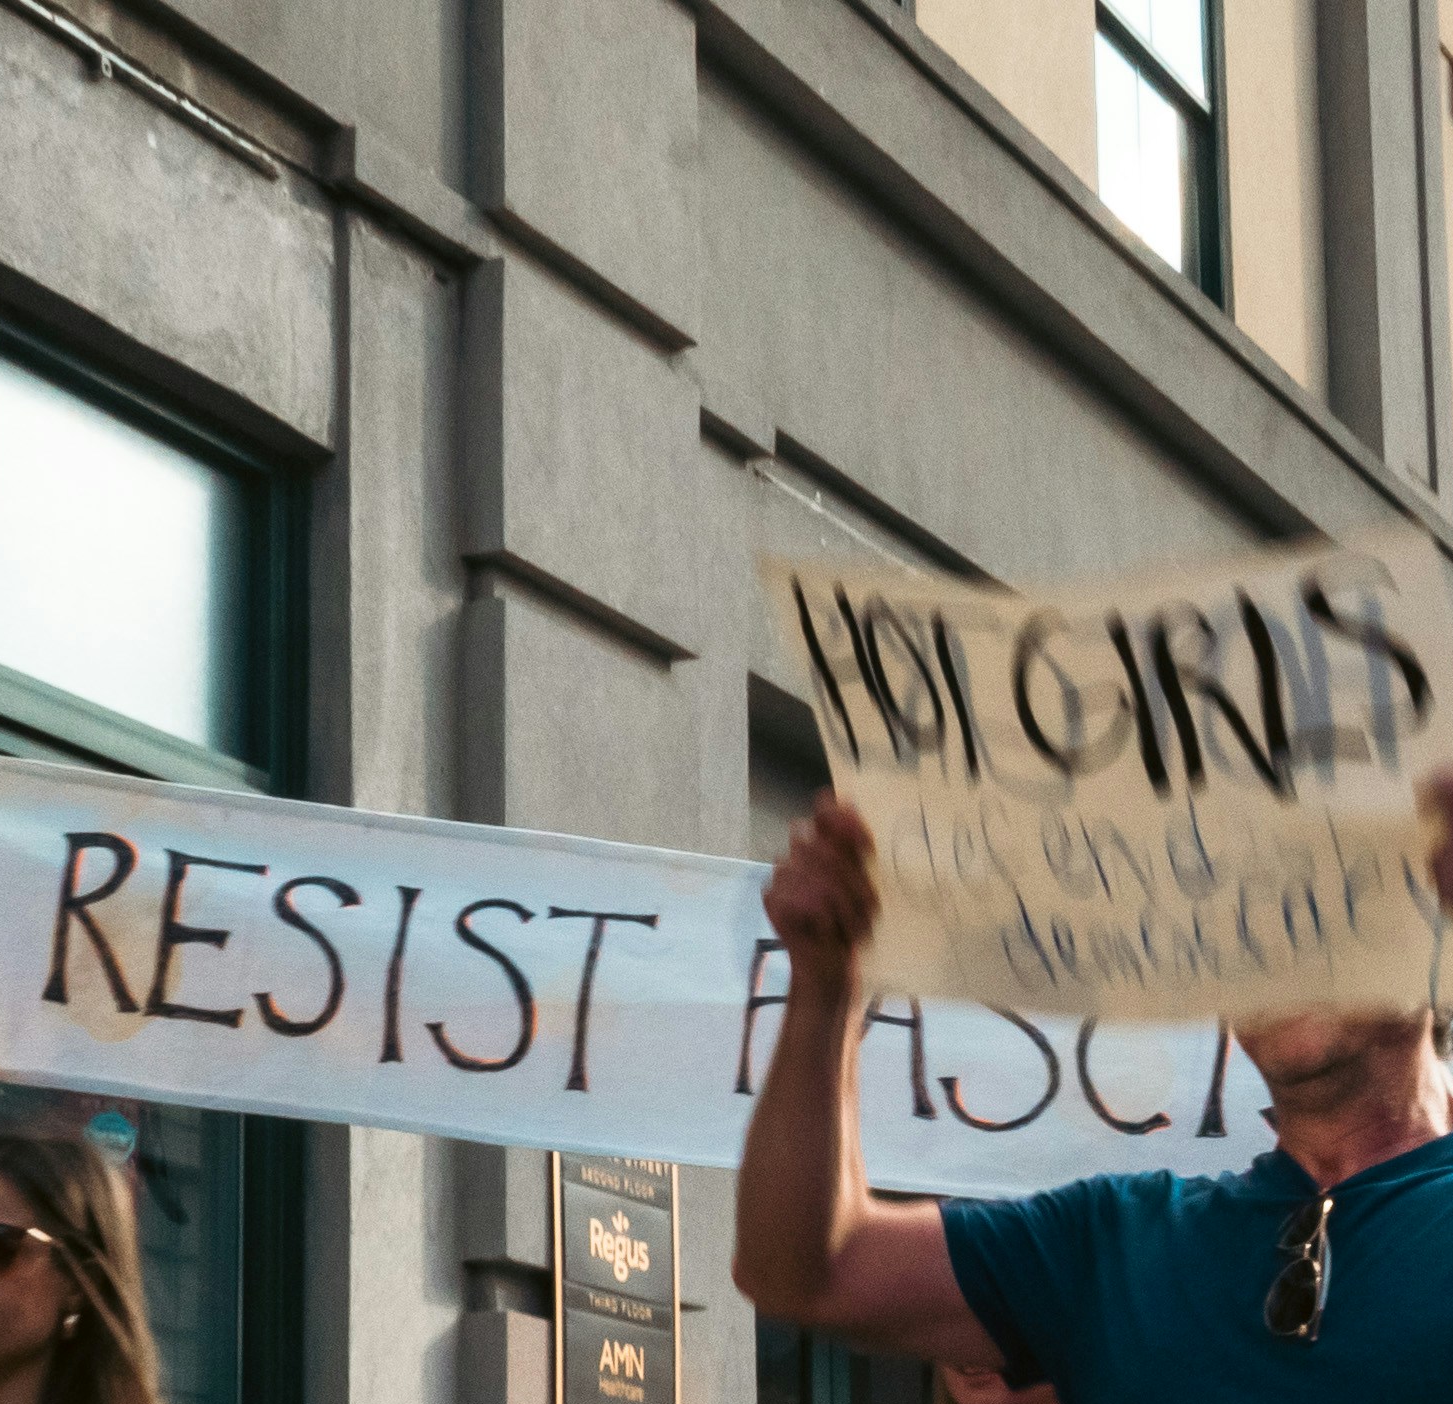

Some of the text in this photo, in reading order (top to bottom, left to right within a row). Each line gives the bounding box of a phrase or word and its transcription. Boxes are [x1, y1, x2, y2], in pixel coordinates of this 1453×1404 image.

[42, 830, 660, 1093] RESIST
[624, 1175, 655, 1200] FLOOR
[589, 1213, 650, 1284] Regus
[621, 1300, 653, 1321] FLOOR
[598, 1338, 645, 1381] AMN
